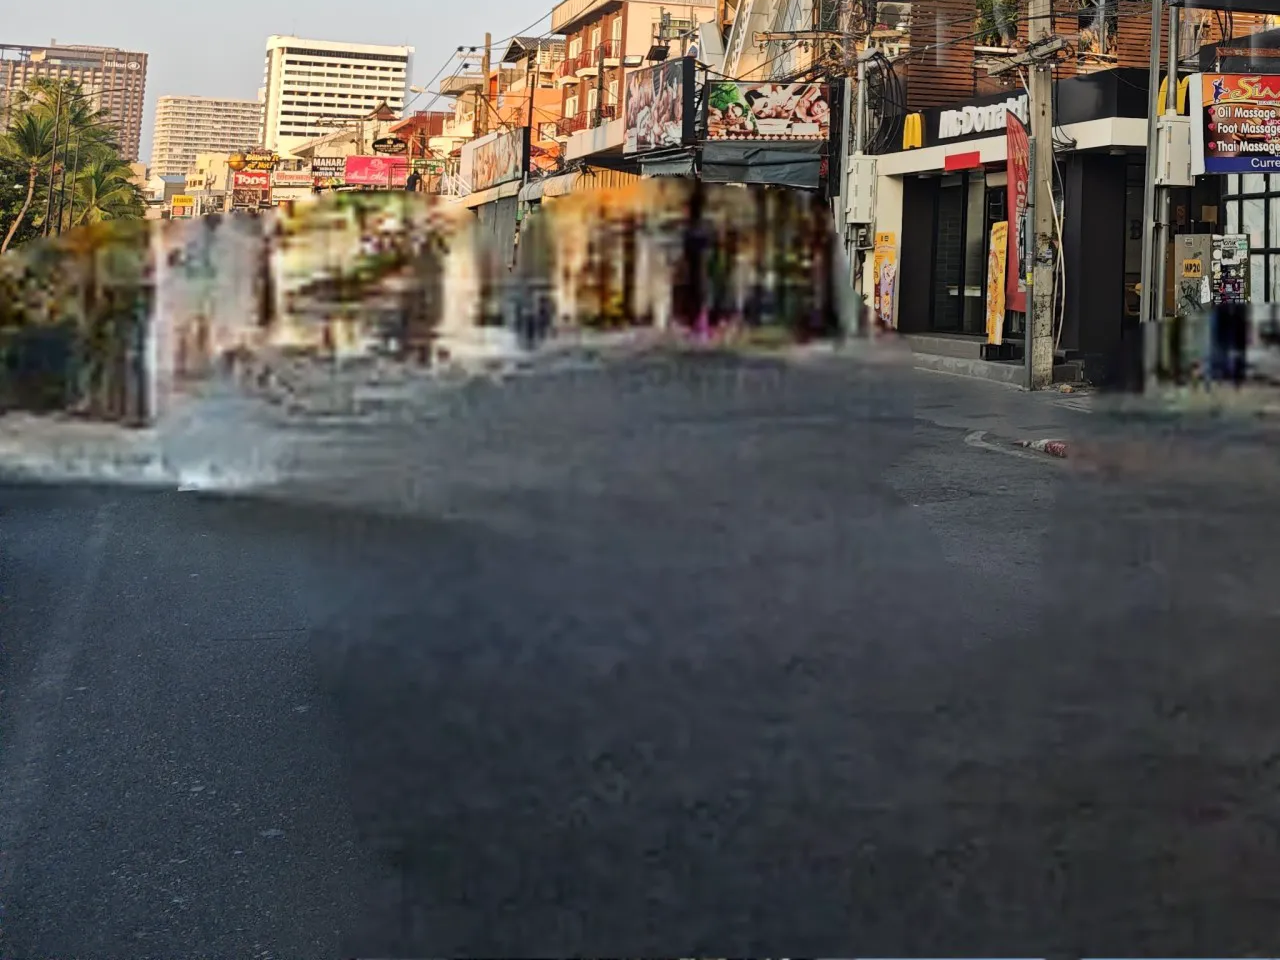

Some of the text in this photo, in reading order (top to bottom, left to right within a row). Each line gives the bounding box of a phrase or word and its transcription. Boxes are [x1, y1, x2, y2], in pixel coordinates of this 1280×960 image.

[1217, 106, 1277, 121] Oil Massage
[1217, 122, 1238, 134] Foot
[1217, 141, 1280, 155] Thai Massage
